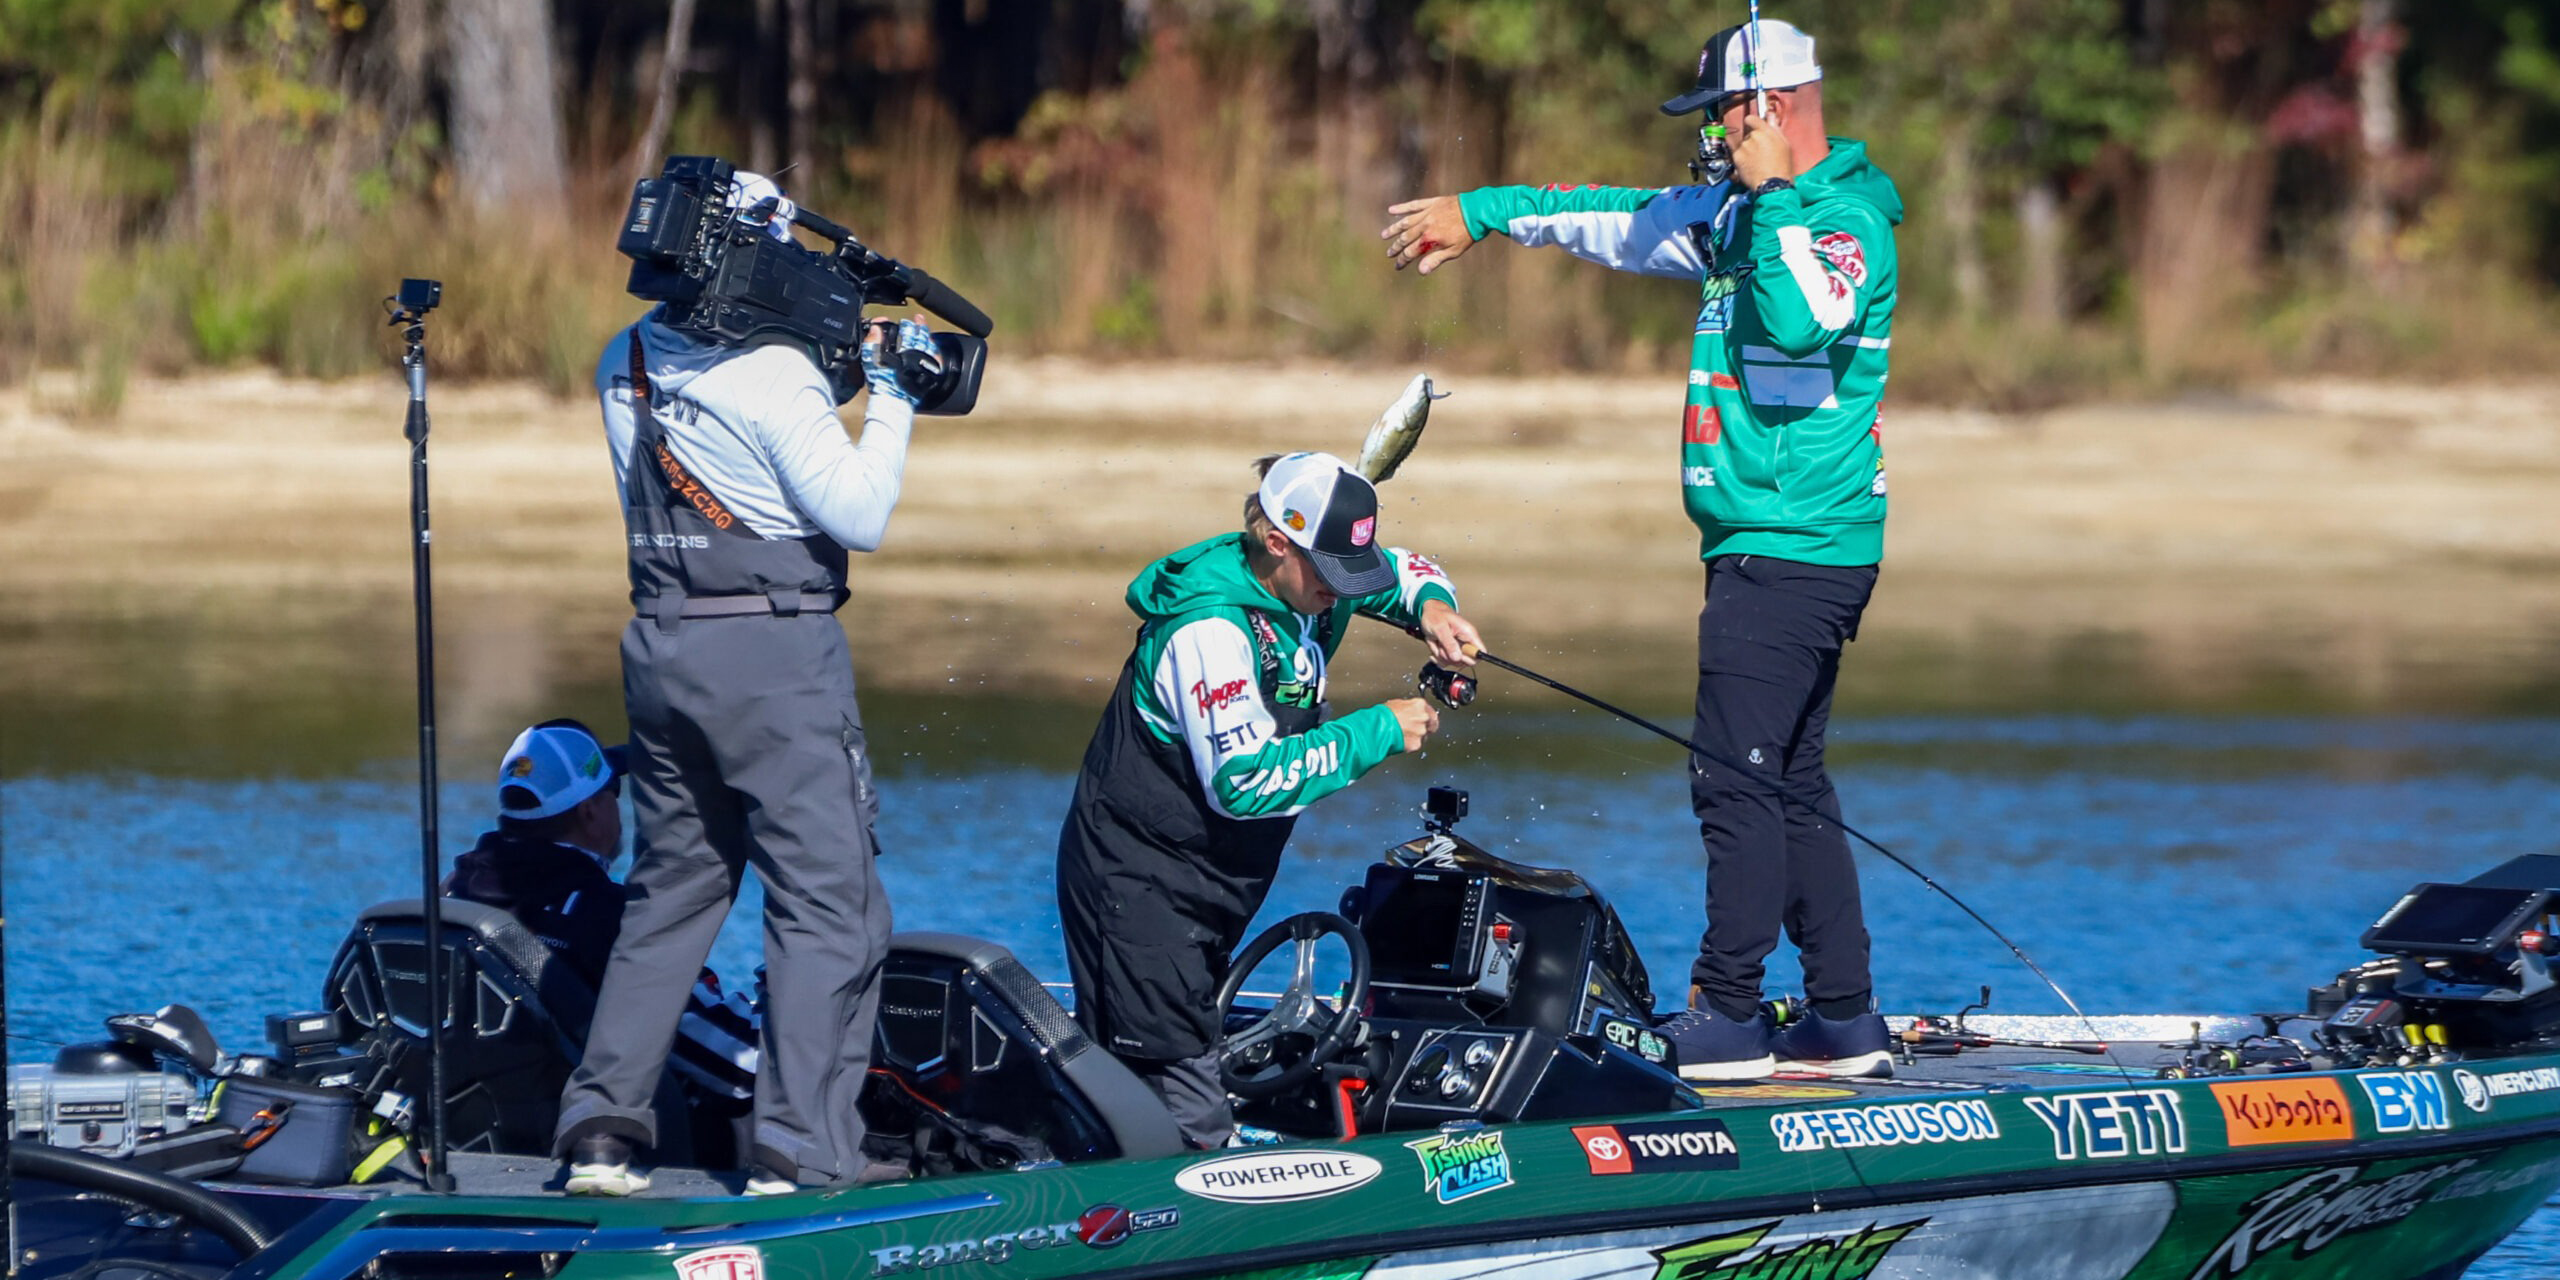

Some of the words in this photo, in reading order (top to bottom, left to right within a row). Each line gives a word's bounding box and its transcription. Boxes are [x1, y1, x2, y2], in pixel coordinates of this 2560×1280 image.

[1191, 679, 1248, 718] Ranger
[1205, 721, 1258, 755] YETI
[2482, 1067, 2560, 1096] MERCURY
[1808, 1099, 1998, 1149] FERGUSON
[2026, 1090, 2185, 1158] YETI
[2228, 1088, 2342, 1130] Kubota
[1414, 1135, 1501, 1183] FISHING
[1628, 1131, 1737, 1158] TOYOTA
[1202, 1159, 1355, 1189] POWER-POLE
[1441, 1154, 1506, 1200] CLASH
[869, 1220, 1078, 1277] Ranger
